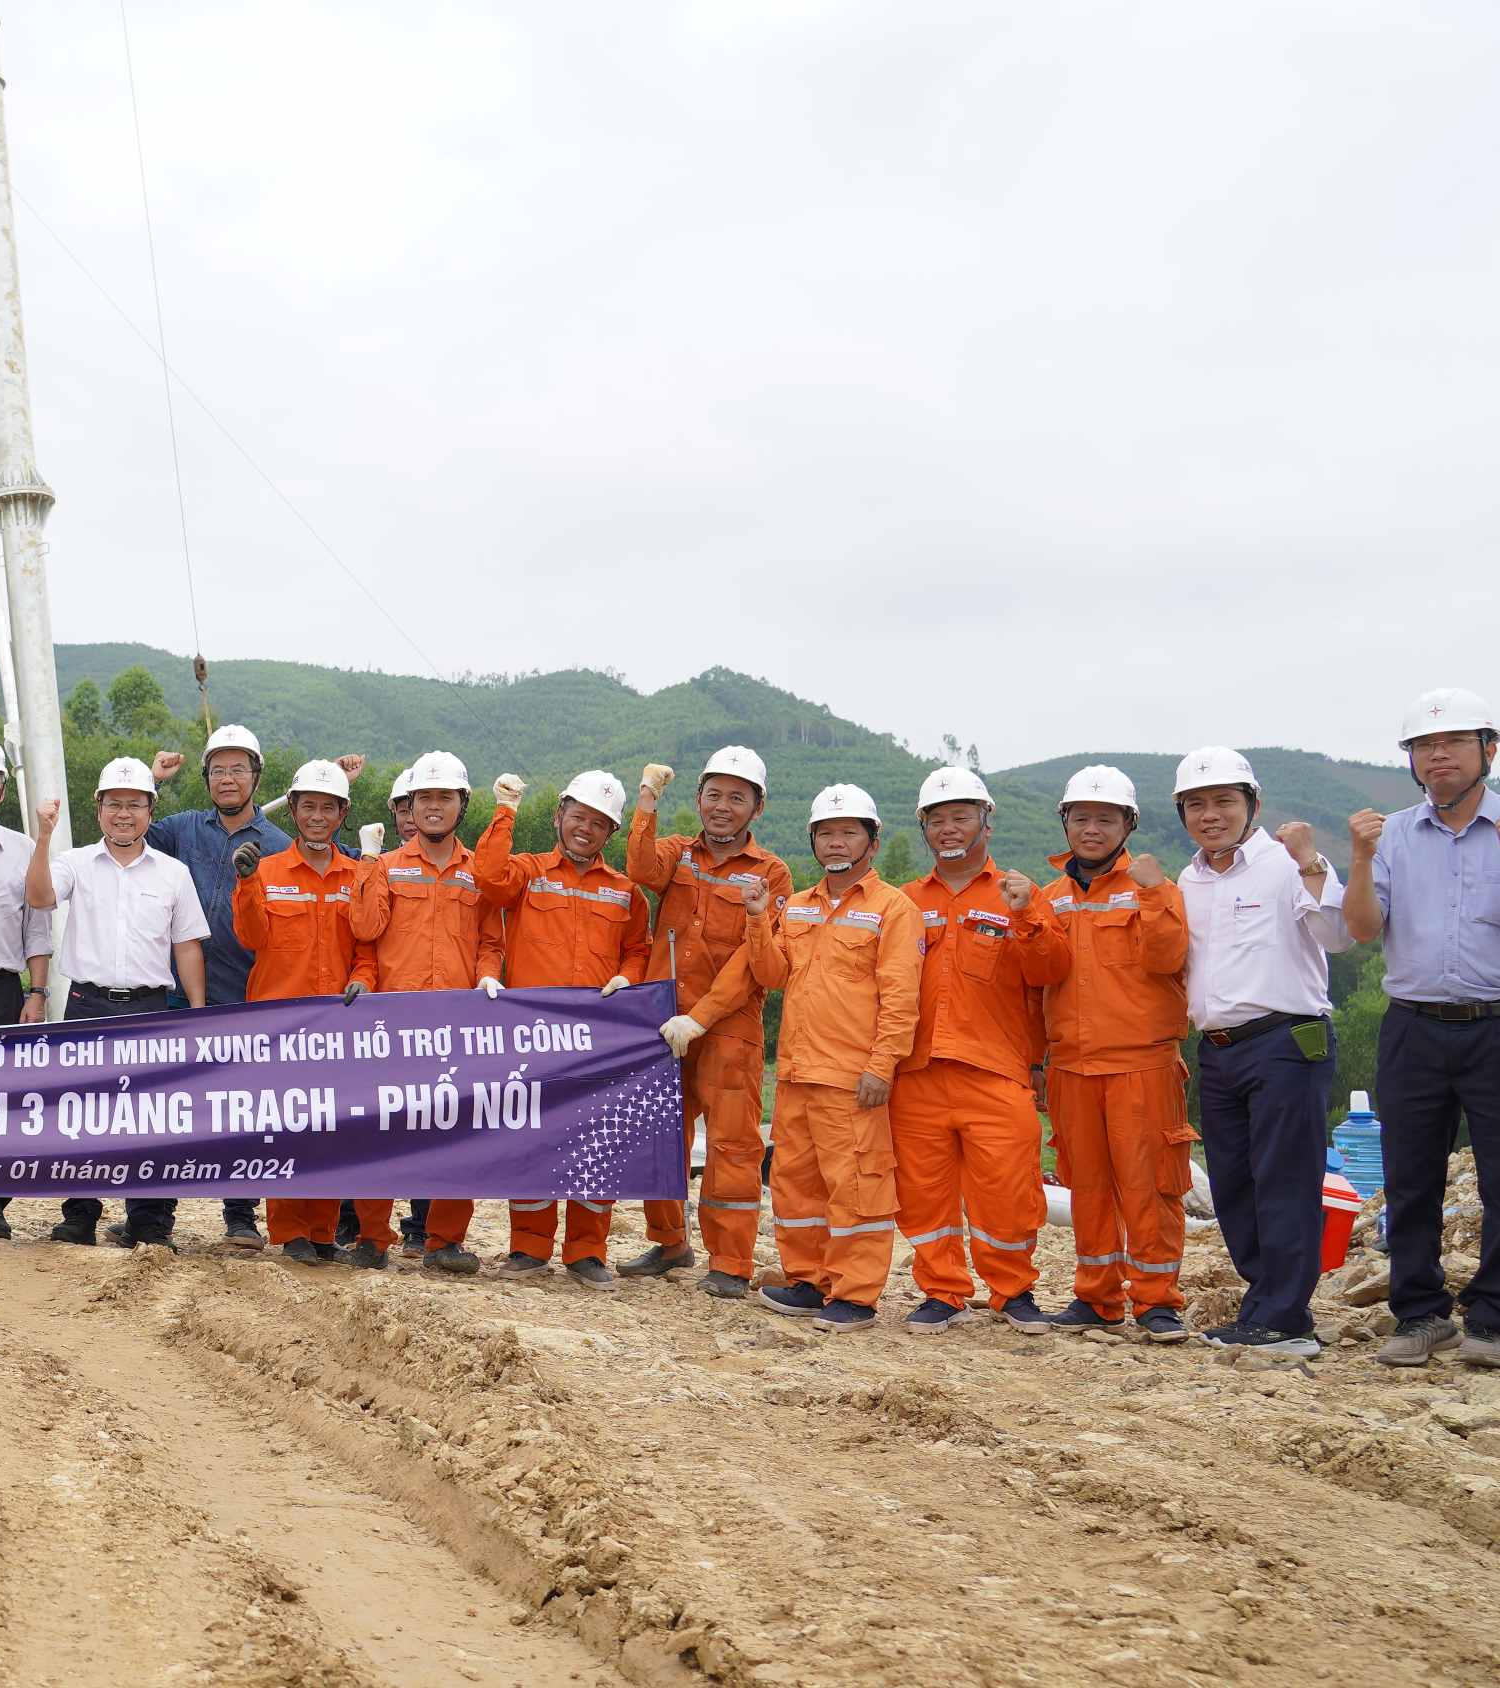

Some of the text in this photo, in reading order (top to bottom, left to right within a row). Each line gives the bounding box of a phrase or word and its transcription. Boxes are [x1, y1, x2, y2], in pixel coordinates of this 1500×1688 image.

[13, 1033, 50, 1068] HỒ
[59, 1035, 105, 1067] CHÍ
[113, 1037, 187, 1065] MINH
[194, 1033, 271, 1063] XUNG
[279, 1027, 345, 1062] KÍCH
[353, 1020, 391, 1059] HỖ
[398, 1024, 452, 1063] TRỢ
[459, 1025, 505, 1055] THI
[512, 1018, 593, 1054] CÔNG
[20, 1092, 44, 1136] 3
[57, 1075, 193, 1141] QUẢNG
[205, 1087, 336, 1143] TRẠCH
[377, 1065, 459, 1131] PHỐ
[472, 1063, 542, 1130] NỐI
[9, 1159, 40, 1180] 01
[50, 1159, 130, 1185] tháng
[138, 1159, 155, 1180] 6
[161, 1158, 222, 1180] năm
[229, 1158, 295, 1180] 2024
